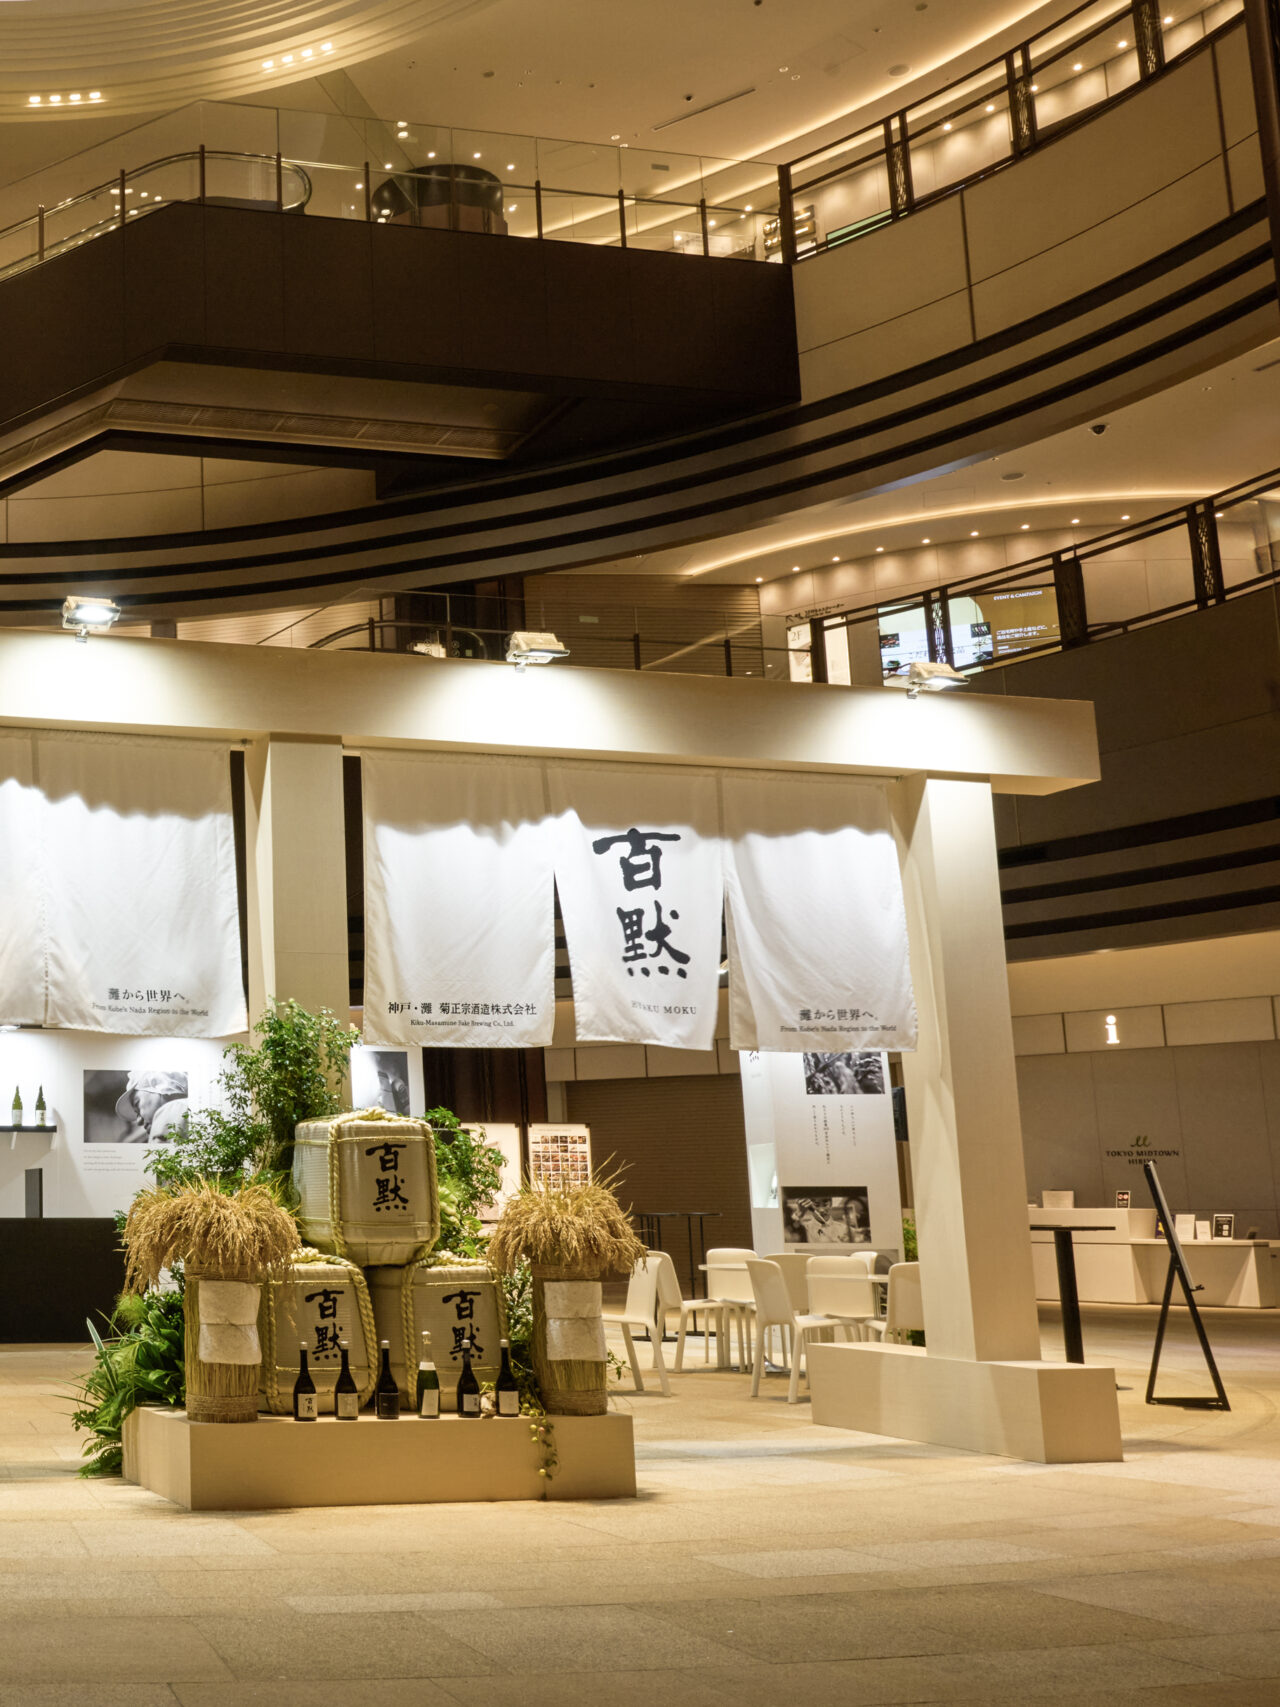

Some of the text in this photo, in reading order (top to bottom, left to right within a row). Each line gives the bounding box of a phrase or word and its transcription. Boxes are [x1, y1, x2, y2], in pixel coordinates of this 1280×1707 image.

[791, 630, 802, 641] 2F
[592, 827, 691, 979] 百黙
[129, 1006, 146, 1014] Nada
[388, 1001, 538, 1016] 神戸・灘 菊正宗酒造株式会社
[663, 1005, 697, 1015] MOKU
[471, 1020, 492, 1028] Brewing
[365, 1142, 409, 1212] 百黙
[305, 1289, 345, 1361] 百黙
